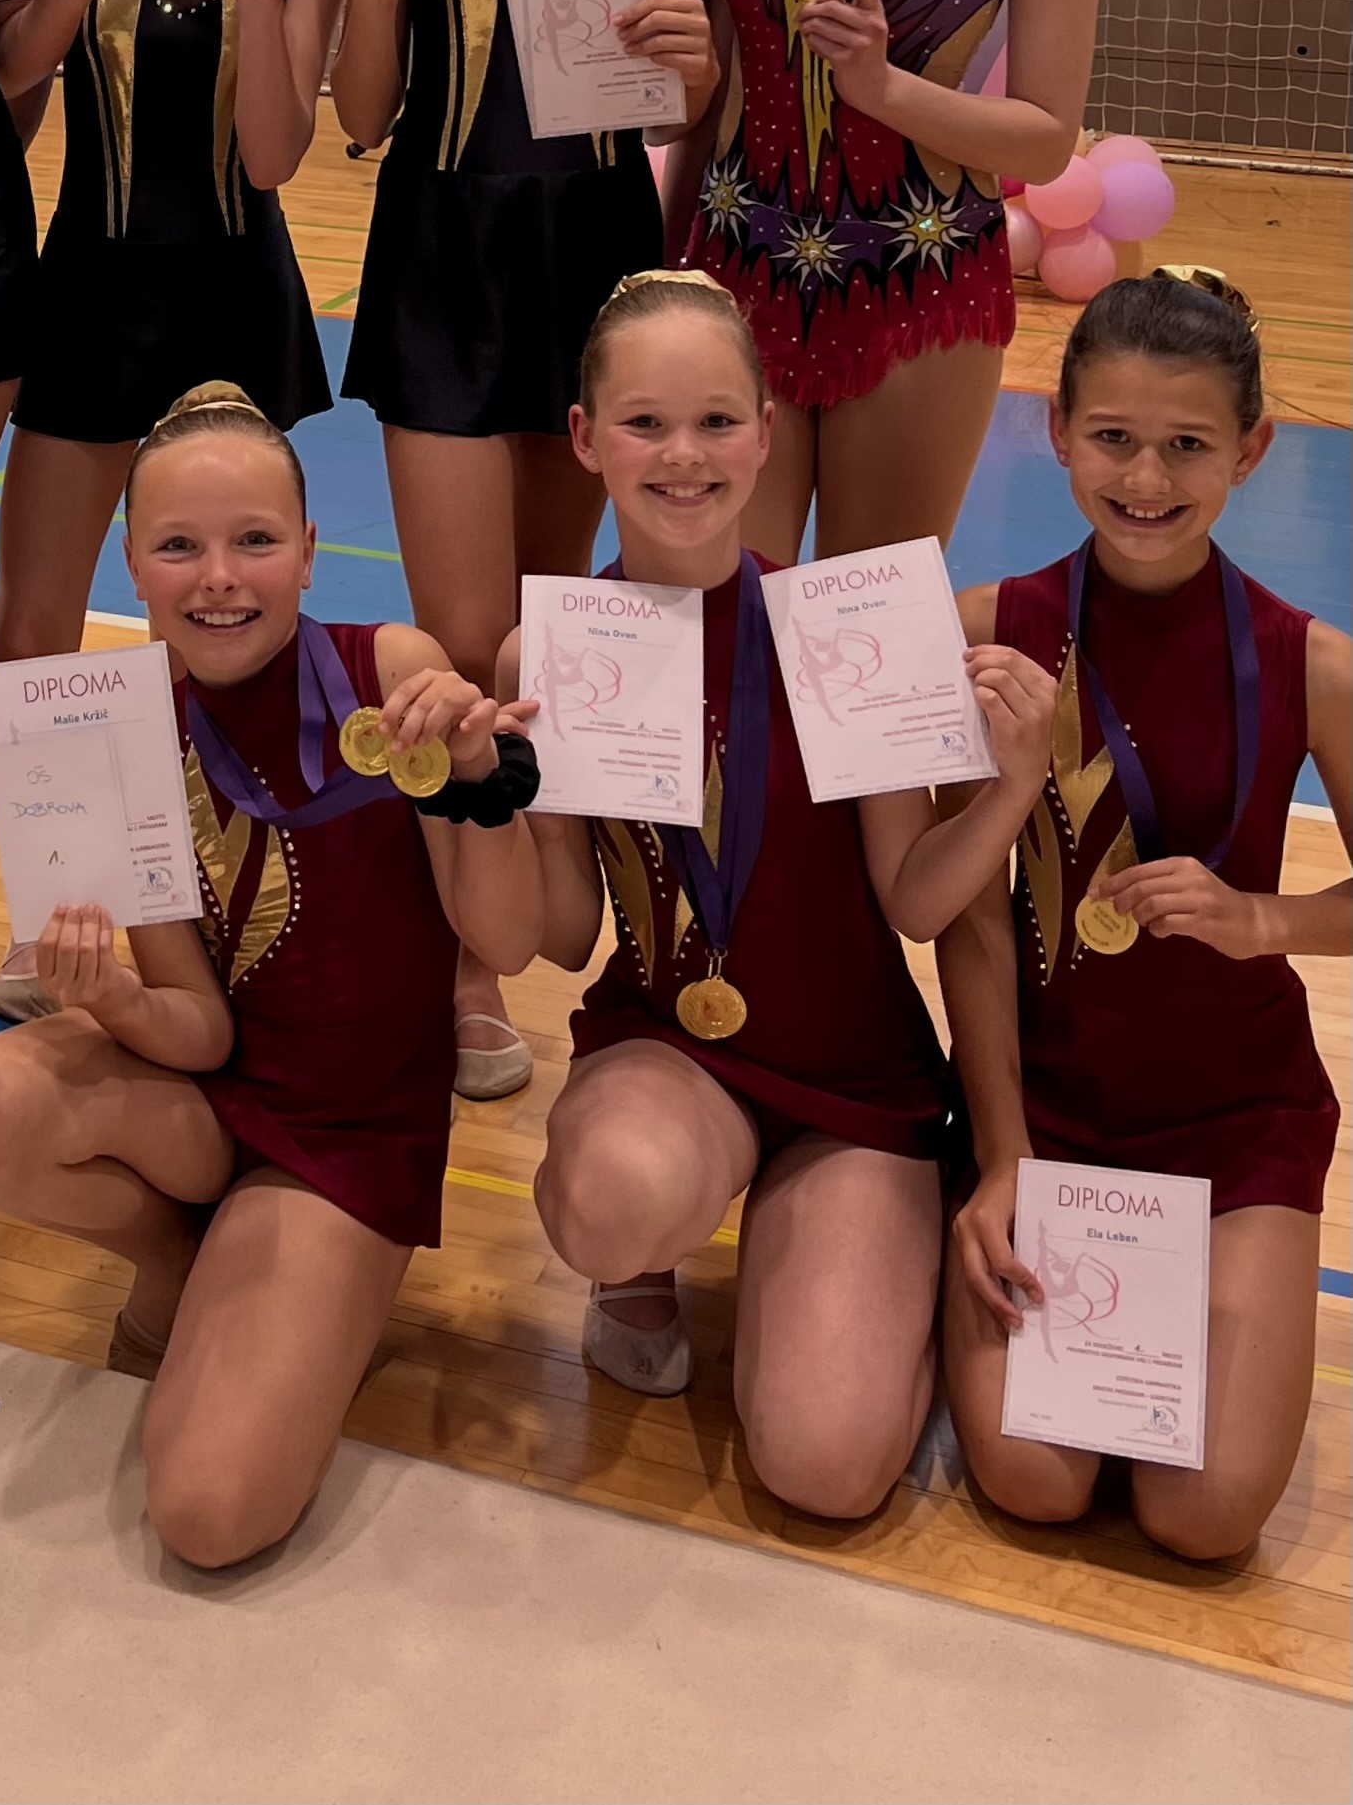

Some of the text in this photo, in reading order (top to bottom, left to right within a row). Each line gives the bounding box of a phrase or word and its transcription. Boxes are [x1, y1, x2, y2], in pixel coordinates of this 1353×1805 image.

[802, 563, 903, 599] DIPLOMA
[562, 593, 662, 620] DIPLOMA
[23, 670, 126, 704] DIPLOMA
[10, 801, 88, 820] DOBROVA
[1058, 1184, 1164, 1220] DIPLOMA
